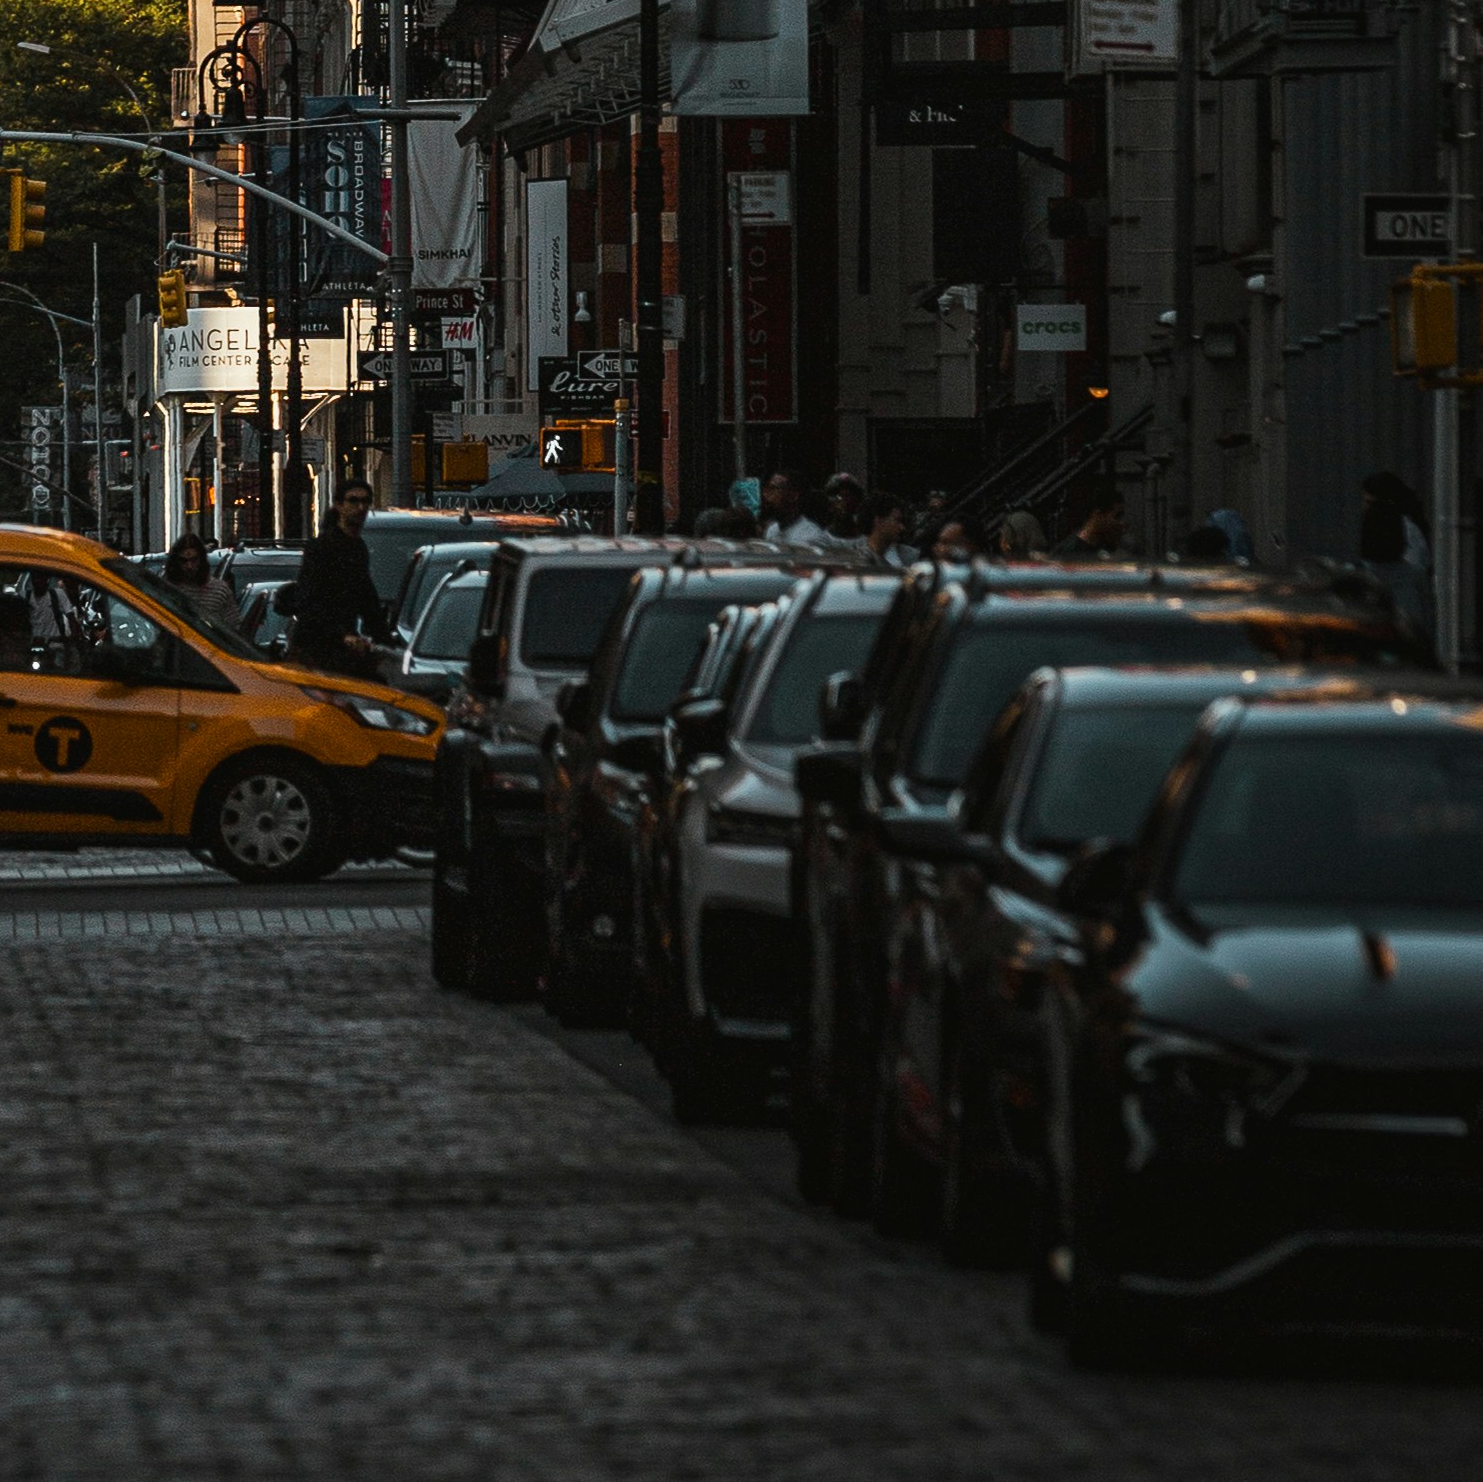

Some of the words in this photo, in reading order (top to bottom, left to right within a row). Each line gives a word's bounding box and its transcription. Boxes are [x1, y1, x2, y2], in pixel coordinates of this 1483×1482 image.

[1391, 214, 1447, 238] ONE
[321, 282, 367, 290] ATHLETA
[416, 294, 448, 309] Prince
[452, 294, 464, 309] St
[748, 225, 768, 413] HOLASTIC
[300, 323, 330, 332] HLETA
[1022, 321, 1082, 334] crocs
[179, 328, 310, 351] ANGELKA
[179, 355, 199, 368] FILM
[202, 354, 252, 367] CENTER
[271, 354, 311, 366] CAE
[374, 360, 392, 372] ON
[595, 360, 619, 372] ONE
[48, 725, 81, 768] T
